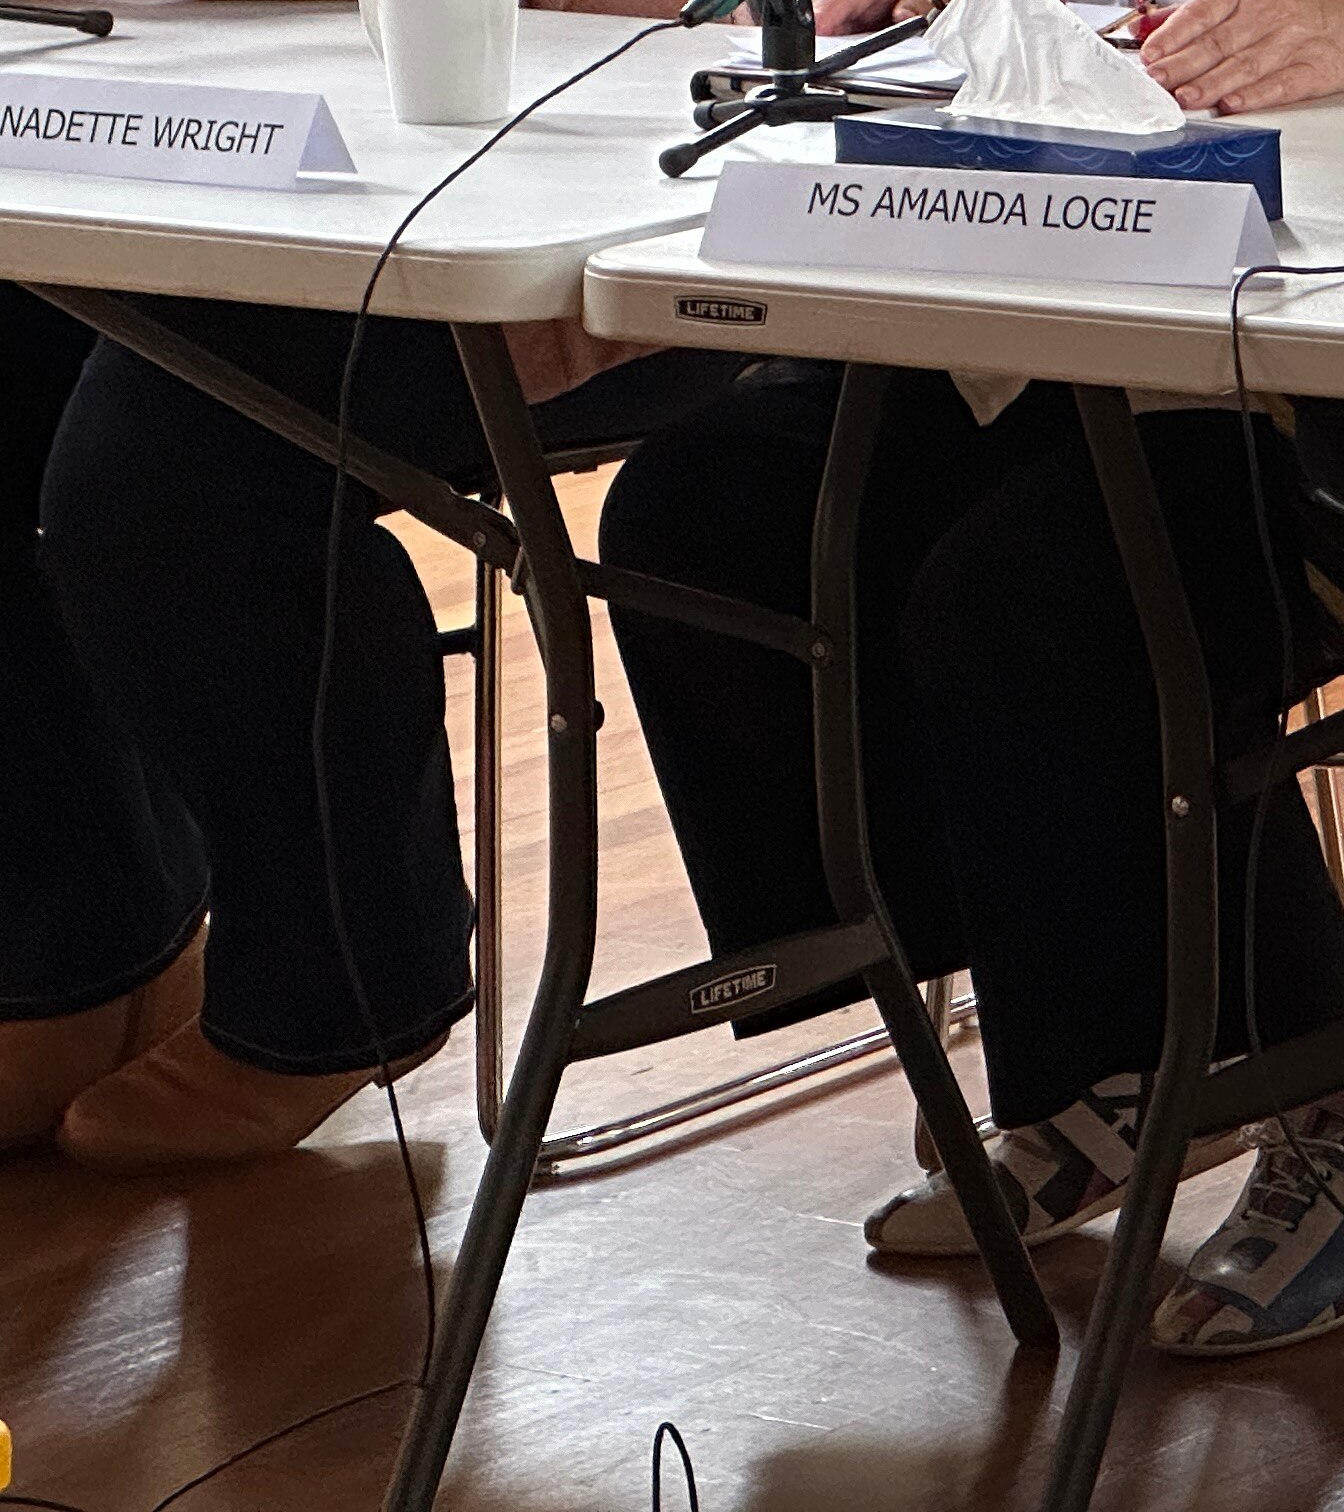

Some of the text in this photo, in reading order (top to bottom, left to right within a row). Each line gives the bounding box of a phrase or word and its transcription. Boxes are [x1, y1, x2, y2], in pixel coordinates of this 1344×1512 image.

[0, 105, 284, 155] NADETTE WRIGHT
[807, 182, 1157, 234] MS AMANDA LOGIE
[686, 300, 756, 320] LIFETIME
[700, 970, 766, 1006] LIFETIME
